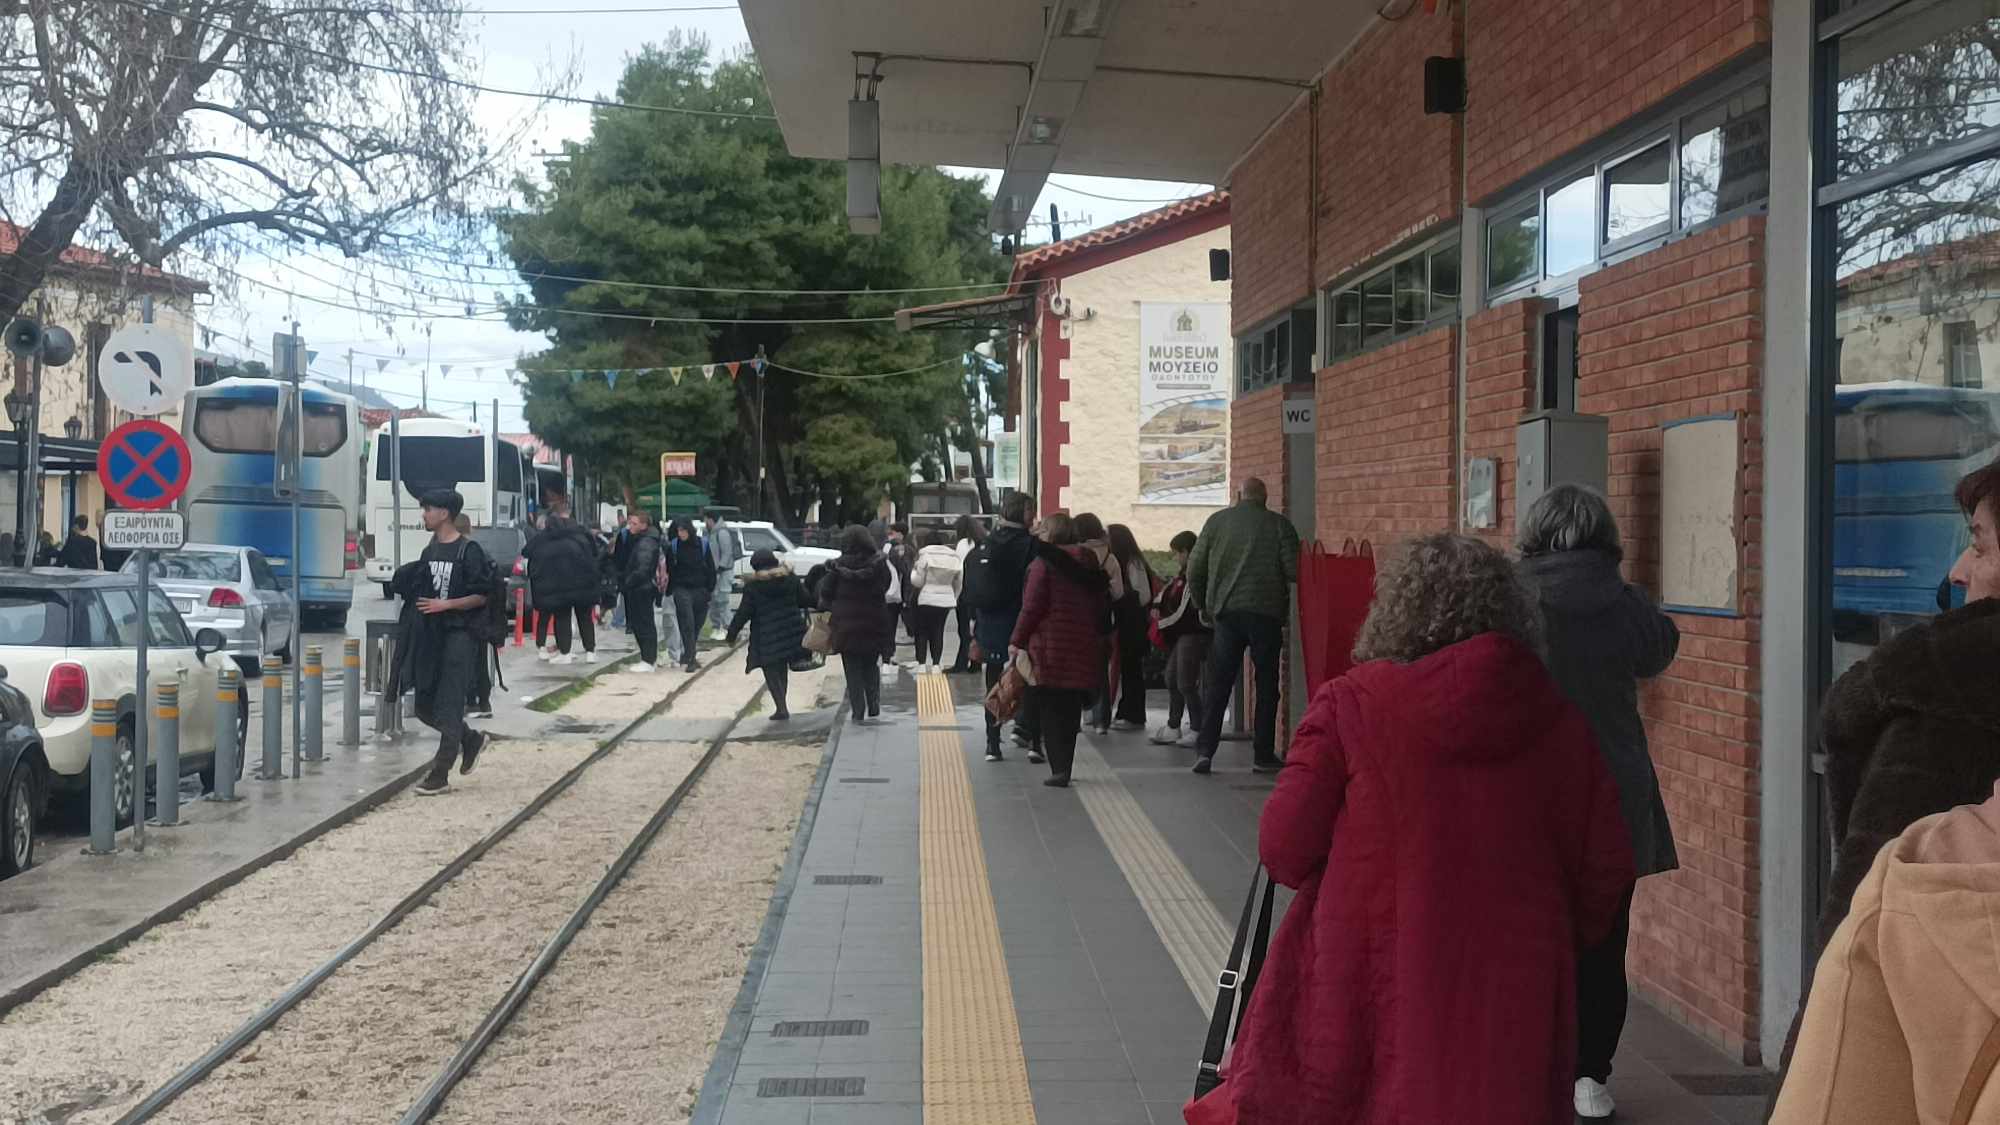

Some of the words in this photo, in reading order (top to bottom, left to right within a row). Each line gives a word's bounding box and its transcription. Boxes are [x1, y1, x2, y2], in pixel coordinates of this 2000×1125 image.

[1149, 346, 1219, 359] MUSEUM
[1149, 361, 1218, 373] ΜΟΥΣΕΙΟ
[1287, 409, 1311, 423] WC
[114, 516, 174, 529] ΕΞΑΙΡΟΥΝΤΑΙ
[108, 531, 160, 545] ΛΕΩΦΟΡΕΙΑ
[162, 531, 180, 545] ΟΣΕ
